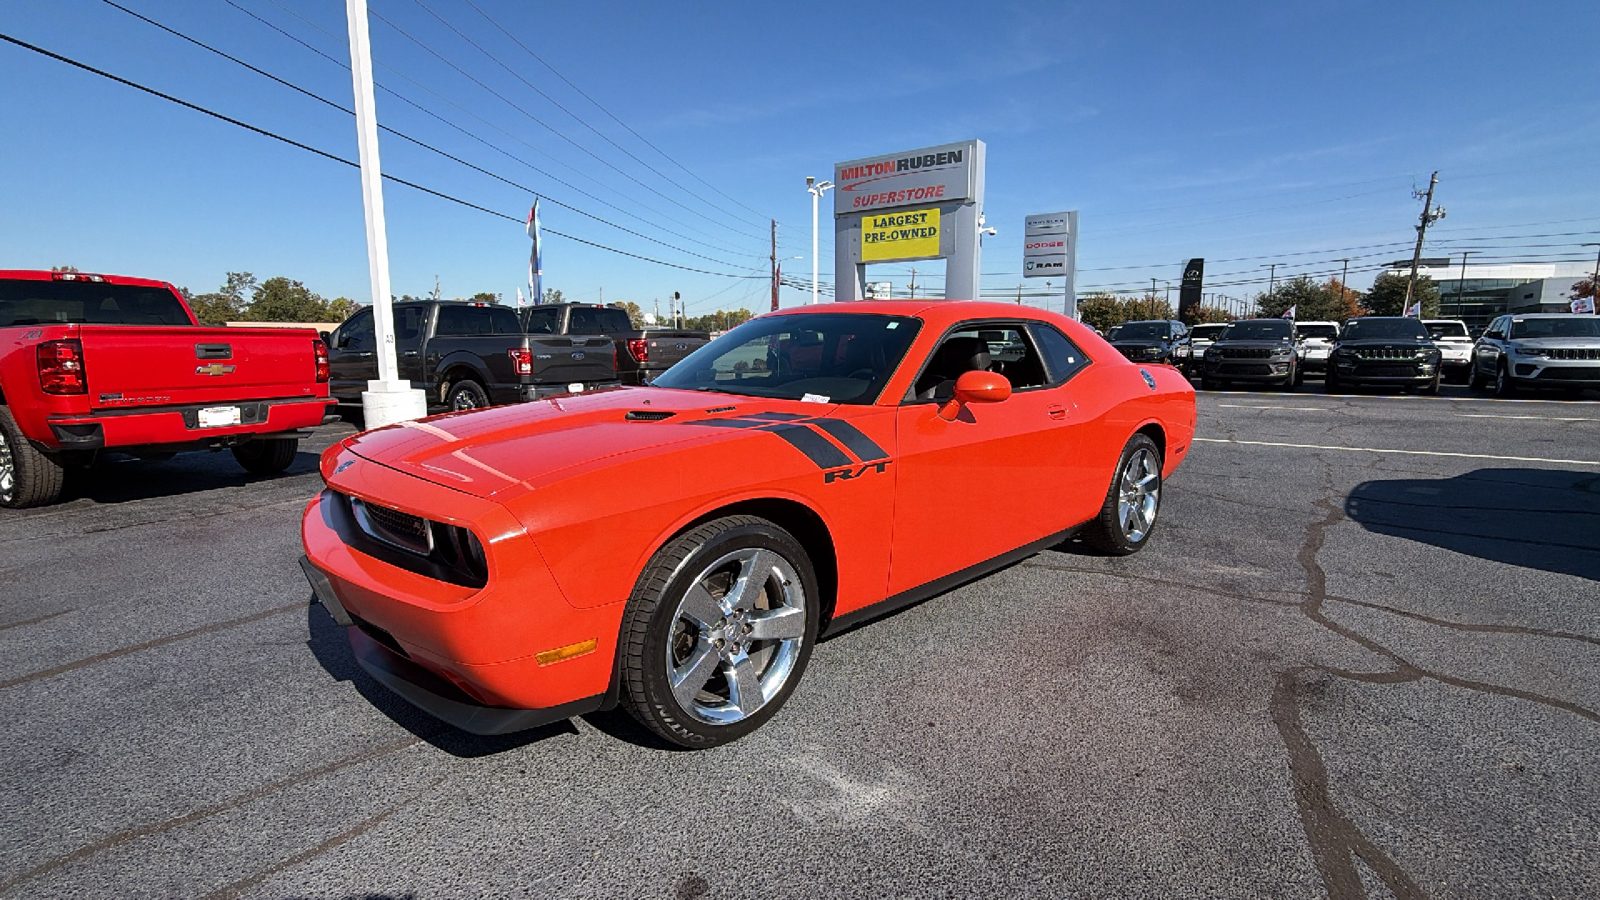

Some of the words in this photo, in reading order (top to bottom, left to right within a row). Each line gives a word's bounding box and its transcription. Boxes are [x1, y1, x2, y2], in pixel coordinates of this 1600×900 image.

[853, 184, 946, 208] SUPERSTORE
[873, 213, 928, 228] LARGEST
[864, 227, 937, 243] PRE-OWNED
[1026, 241, 1064, 249] DODGE
[824, 460, 893, 484] R/T
